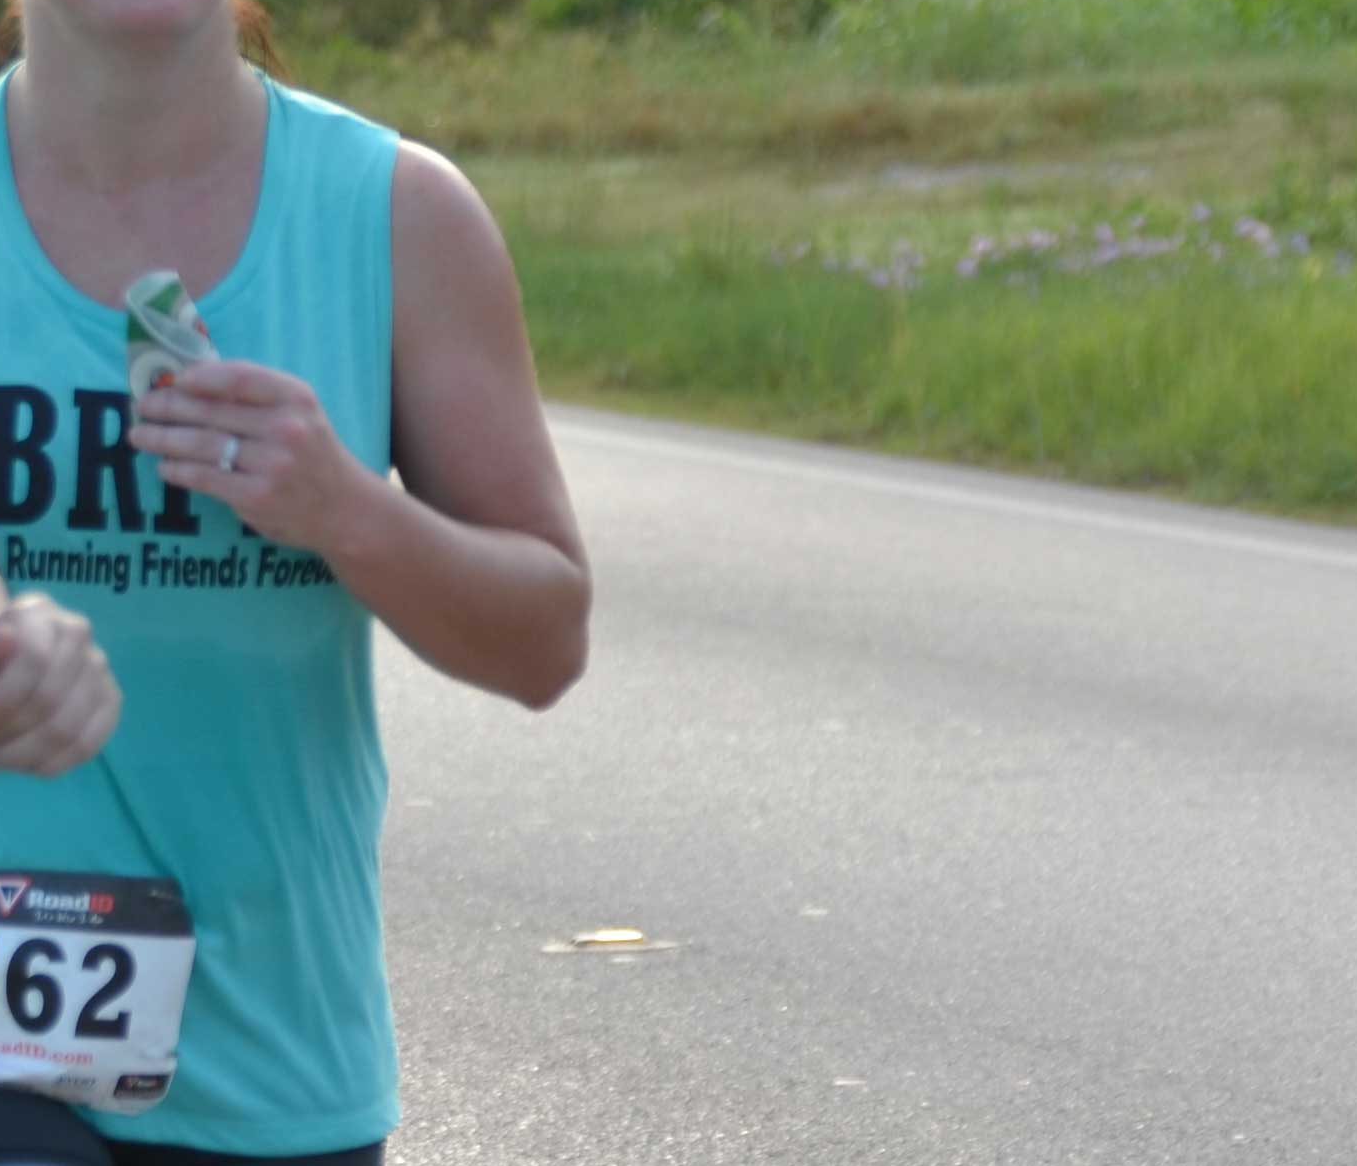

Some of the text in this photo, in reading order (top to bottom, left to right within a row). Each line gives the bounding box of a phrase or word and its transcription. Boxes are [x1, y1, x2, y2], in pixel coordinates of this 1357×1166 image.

[6, 535, 132, 593] Running
[142, 543, 249, 590] Friends
[26, 888, 116, 914] RoadID
